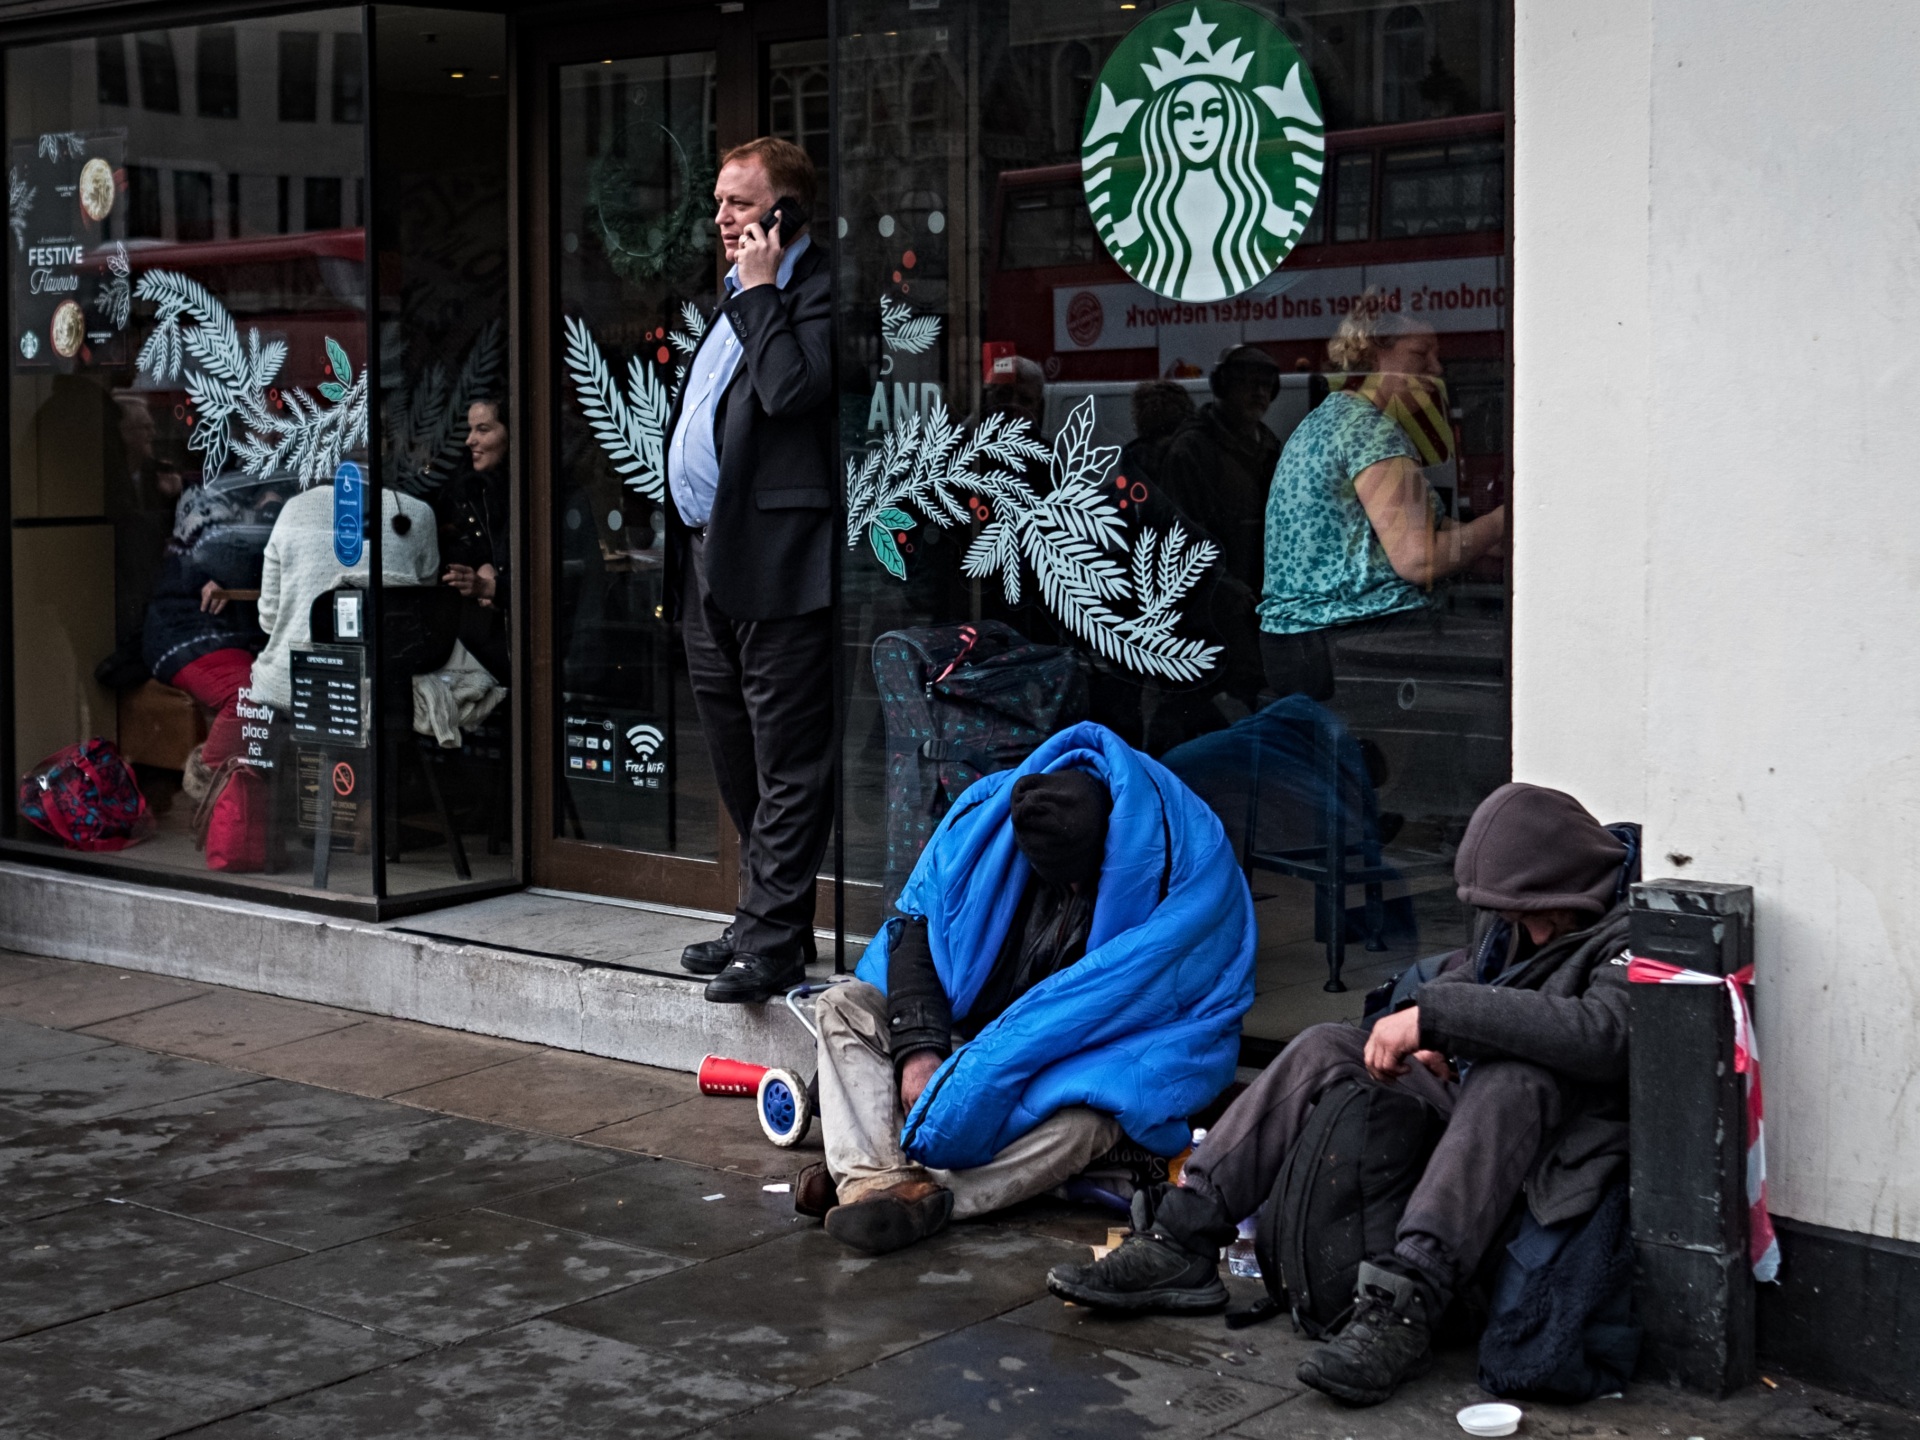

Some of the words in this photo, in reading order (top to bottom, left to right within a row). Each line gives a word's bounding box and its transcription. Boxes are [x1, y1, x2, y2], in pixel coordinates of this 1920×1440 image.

[28, 246, 83, 267] FESTIVE
[30, 268, 79, 295] Flavours
[867, 381, 942, 431] AND
[328, 658, 343, 666] HOURS
[236, 702, 274, 725] friendly
[242, 722, 269, 740] place
[249, 746, 262, 757] nct
[625, 759, 645, 773] Free
[1104, 1147, 1166, 1179] Shoppi
